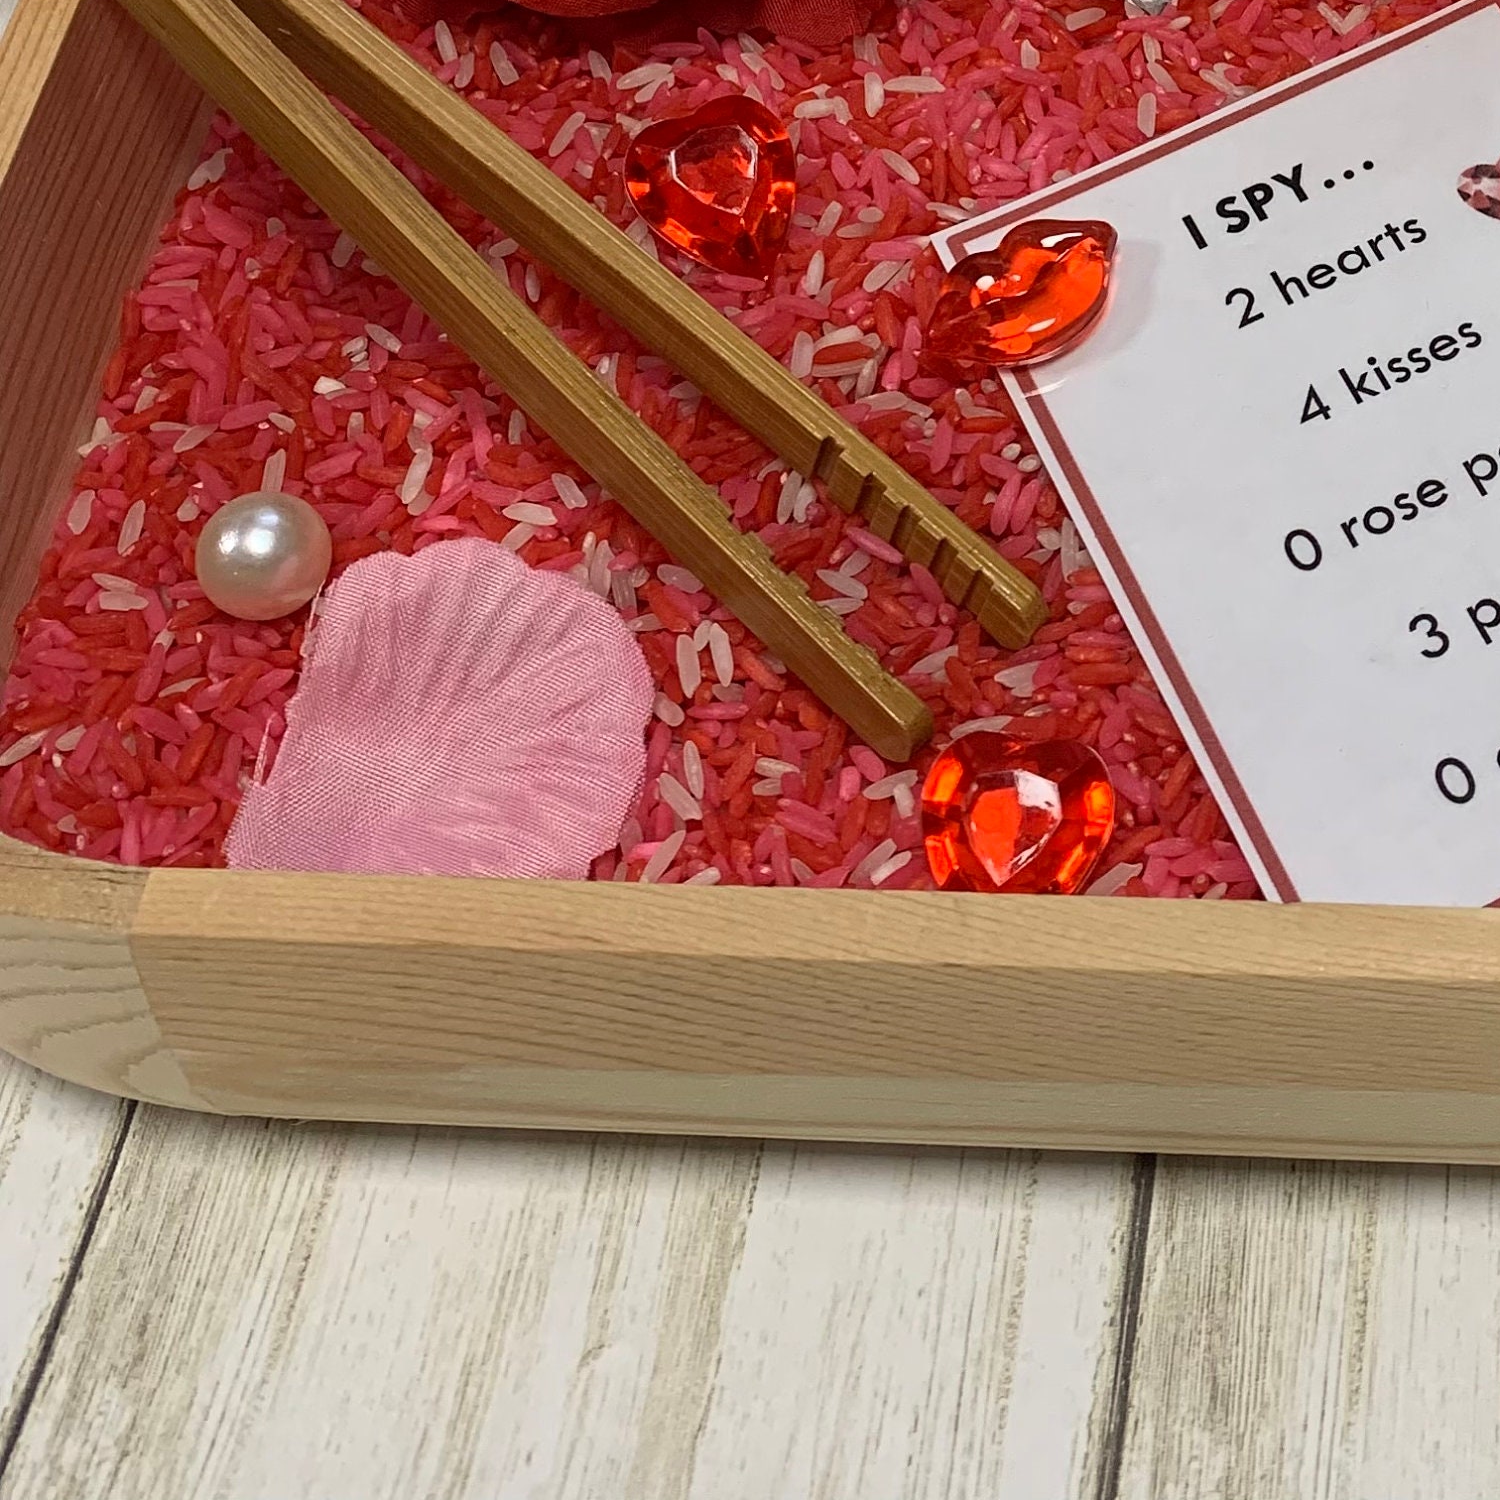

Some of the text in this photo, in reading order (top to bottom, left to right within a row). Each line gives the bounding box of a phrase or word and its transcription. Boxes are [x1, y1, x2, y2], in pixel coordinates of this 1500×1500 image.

[1182, 214, 1208, 250] I
[1225, 219, 1427, 329] 2 hearts
[1300, 323, 1482, 424] 4 kisses
[1340, 479, 1448, 548] rose
[1409, 614, 1450, 658] 3
